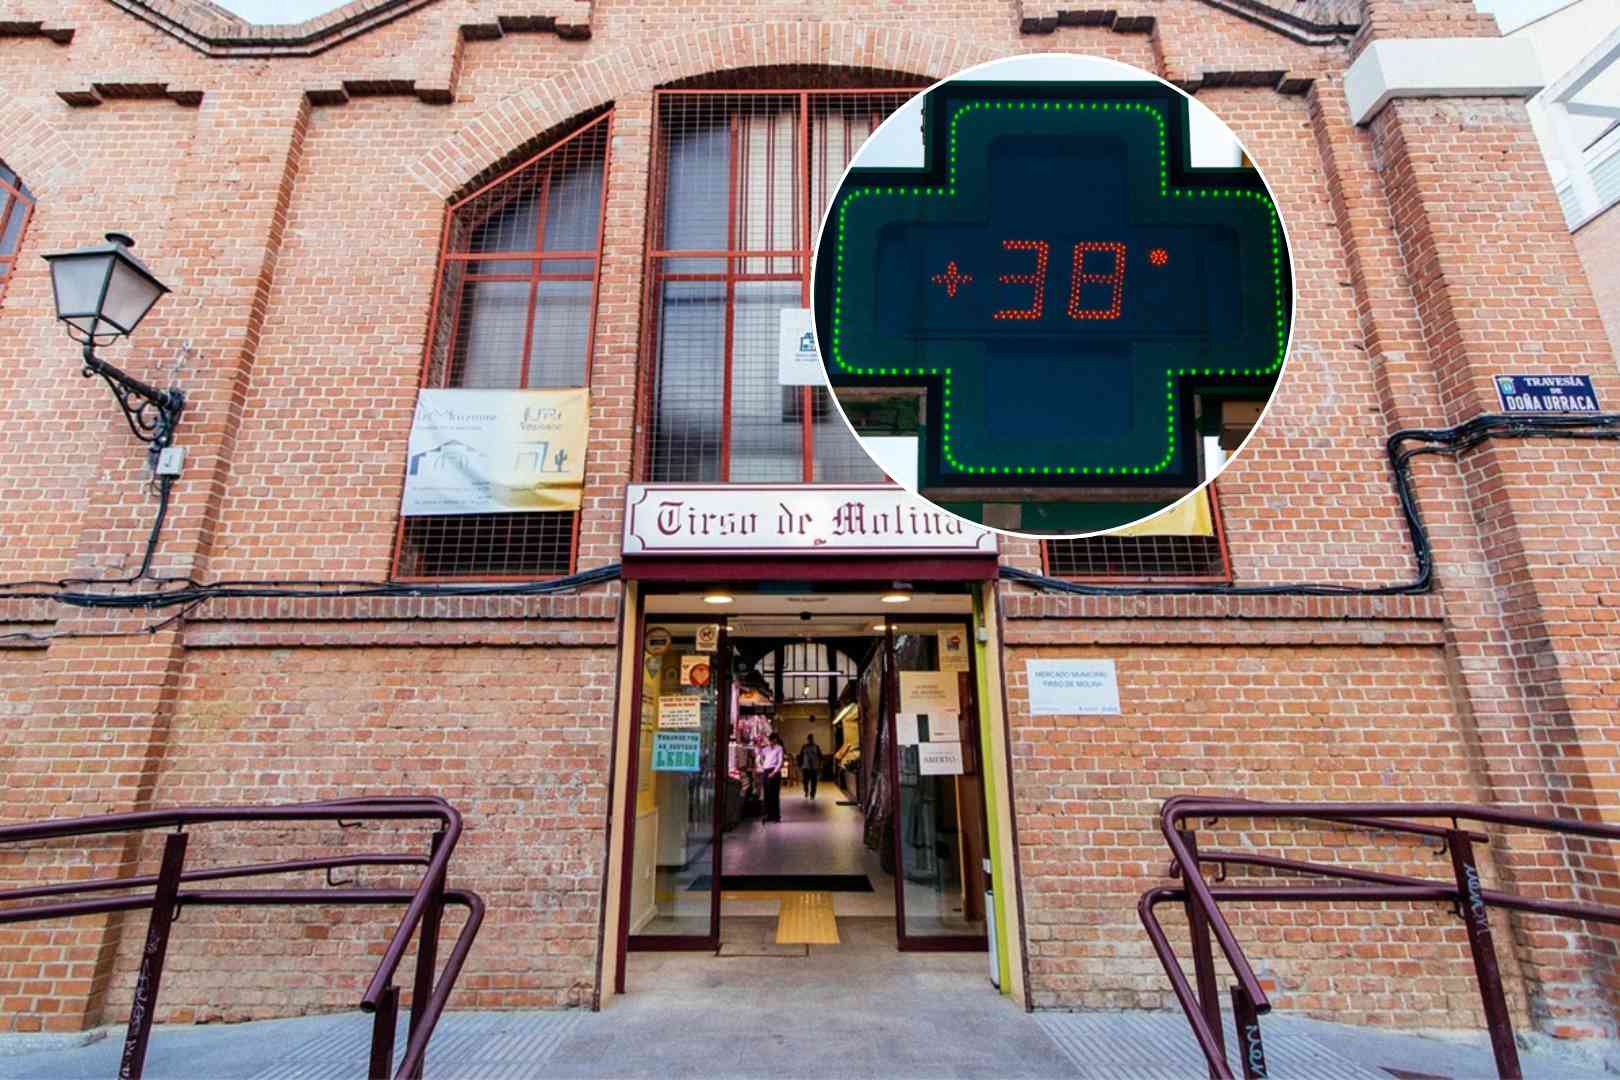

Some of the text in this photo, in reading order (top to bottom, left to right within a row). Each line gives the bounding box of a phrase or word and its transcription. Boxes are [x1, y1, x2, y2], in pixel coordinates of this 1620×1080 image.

[1506, 393, 1597, 411] DOÑA URRACA
[656, 501, 964, 537] Tirso de Molina
